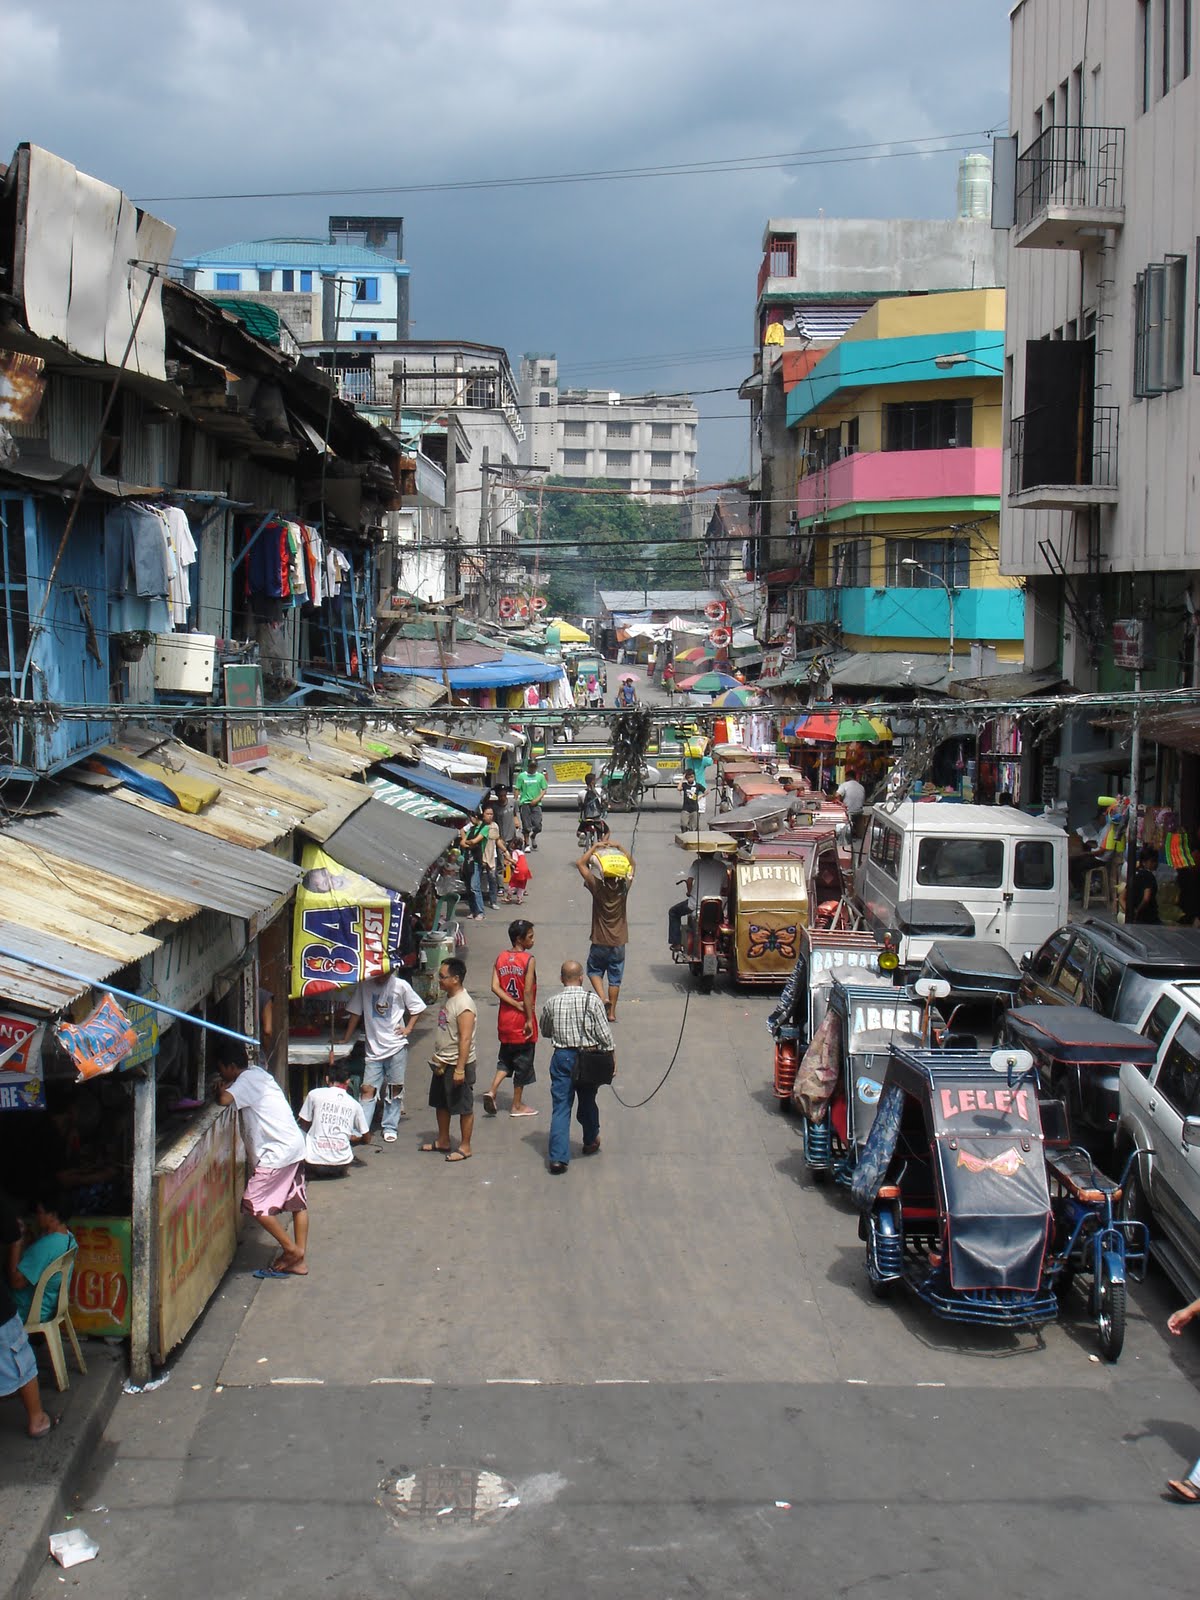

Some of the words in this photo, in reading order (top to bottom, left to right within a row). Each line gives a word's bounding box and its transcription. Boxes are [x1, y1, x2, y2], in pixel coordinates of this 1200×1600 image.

[505, 977, 520, 1000] 4
[0, 1086, 19, 1109] RE
[940, 1088, 1029, 1121] LELET
